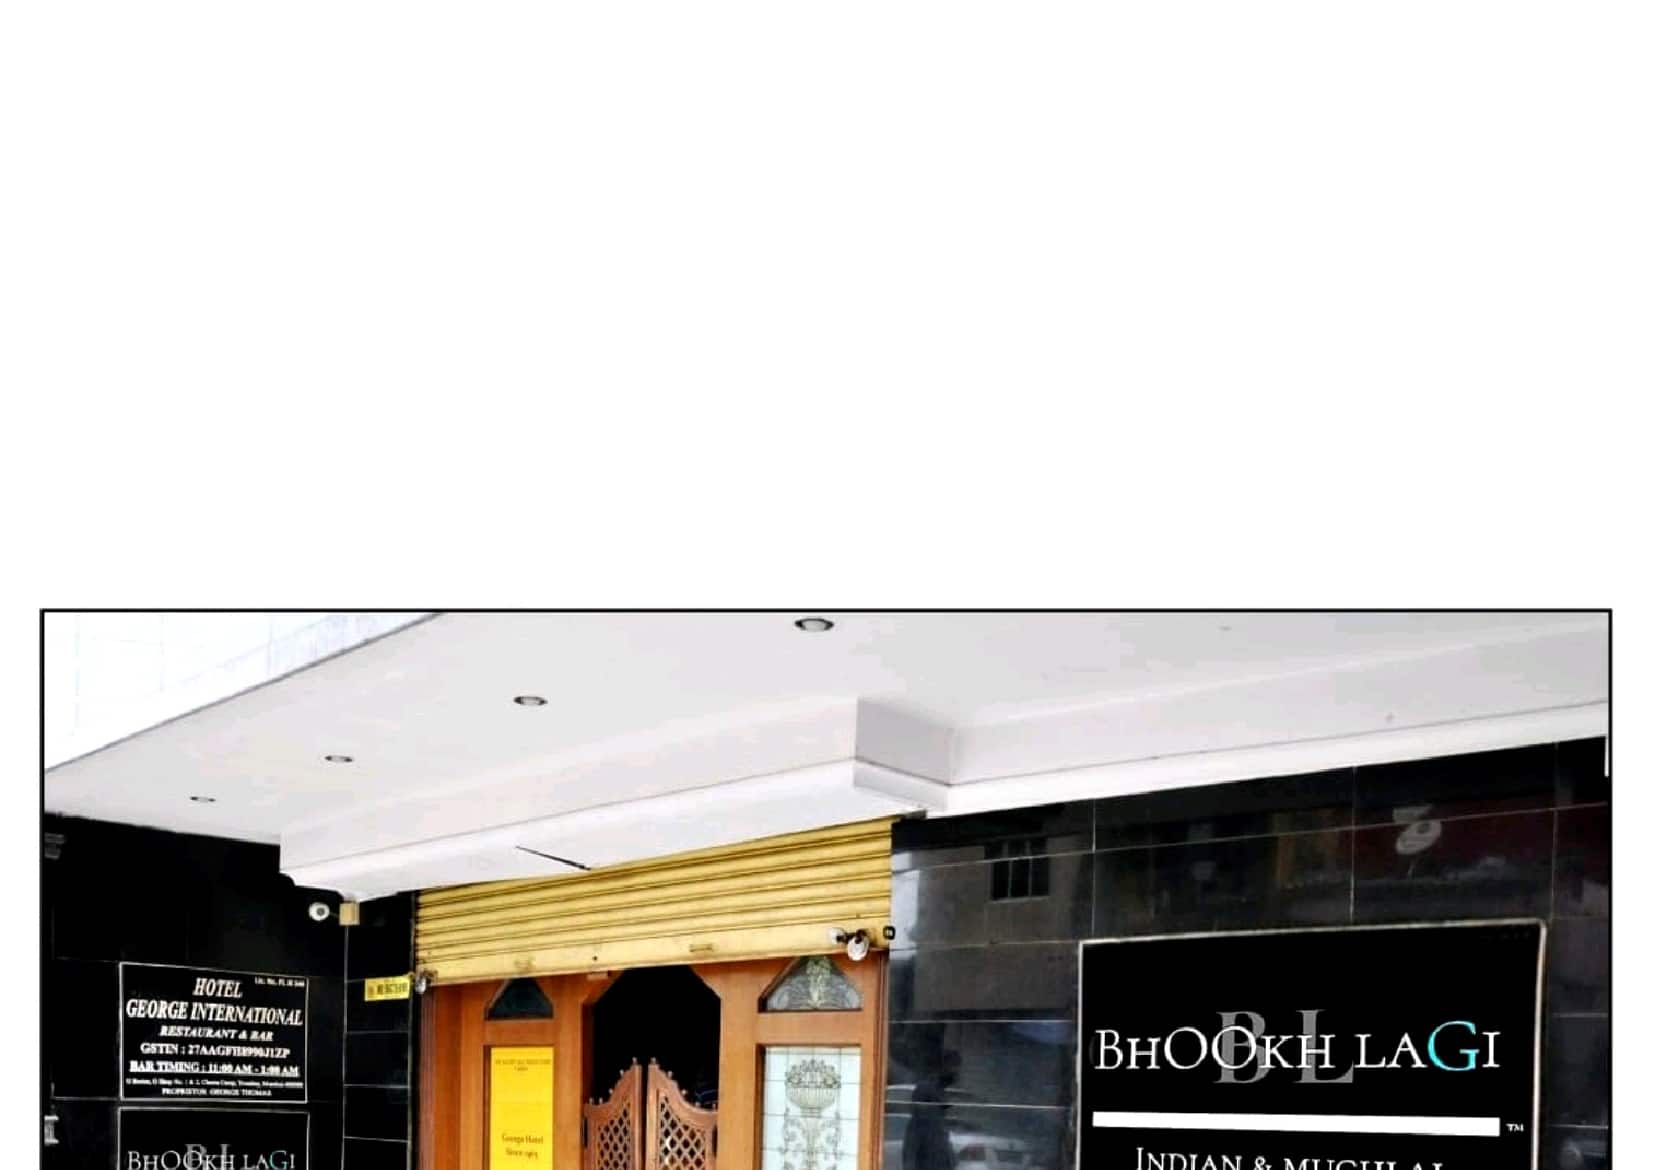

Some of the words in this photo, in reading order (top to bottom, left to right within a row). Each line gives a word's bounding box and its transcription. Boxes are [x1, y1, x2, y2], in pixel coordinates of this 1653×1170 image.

[192, 977, 243, 998] HOTEL
[126, 999, 189, 1020] GEORGE
[190, 1002, 303, 1026] INTERNATIONAL
[159, 1025, 238, 1039] RESTAURANT
[250, 1030, 274, 1042] BAR
[140, 1042, 179, 1055] GSTIN
[129, 1060, 155, 1073] BAR
[156, 1061, 200, 1074] TIMING
[235, 1063, 253, 1075] AM
[281, 1064, 299, 1077] AM
